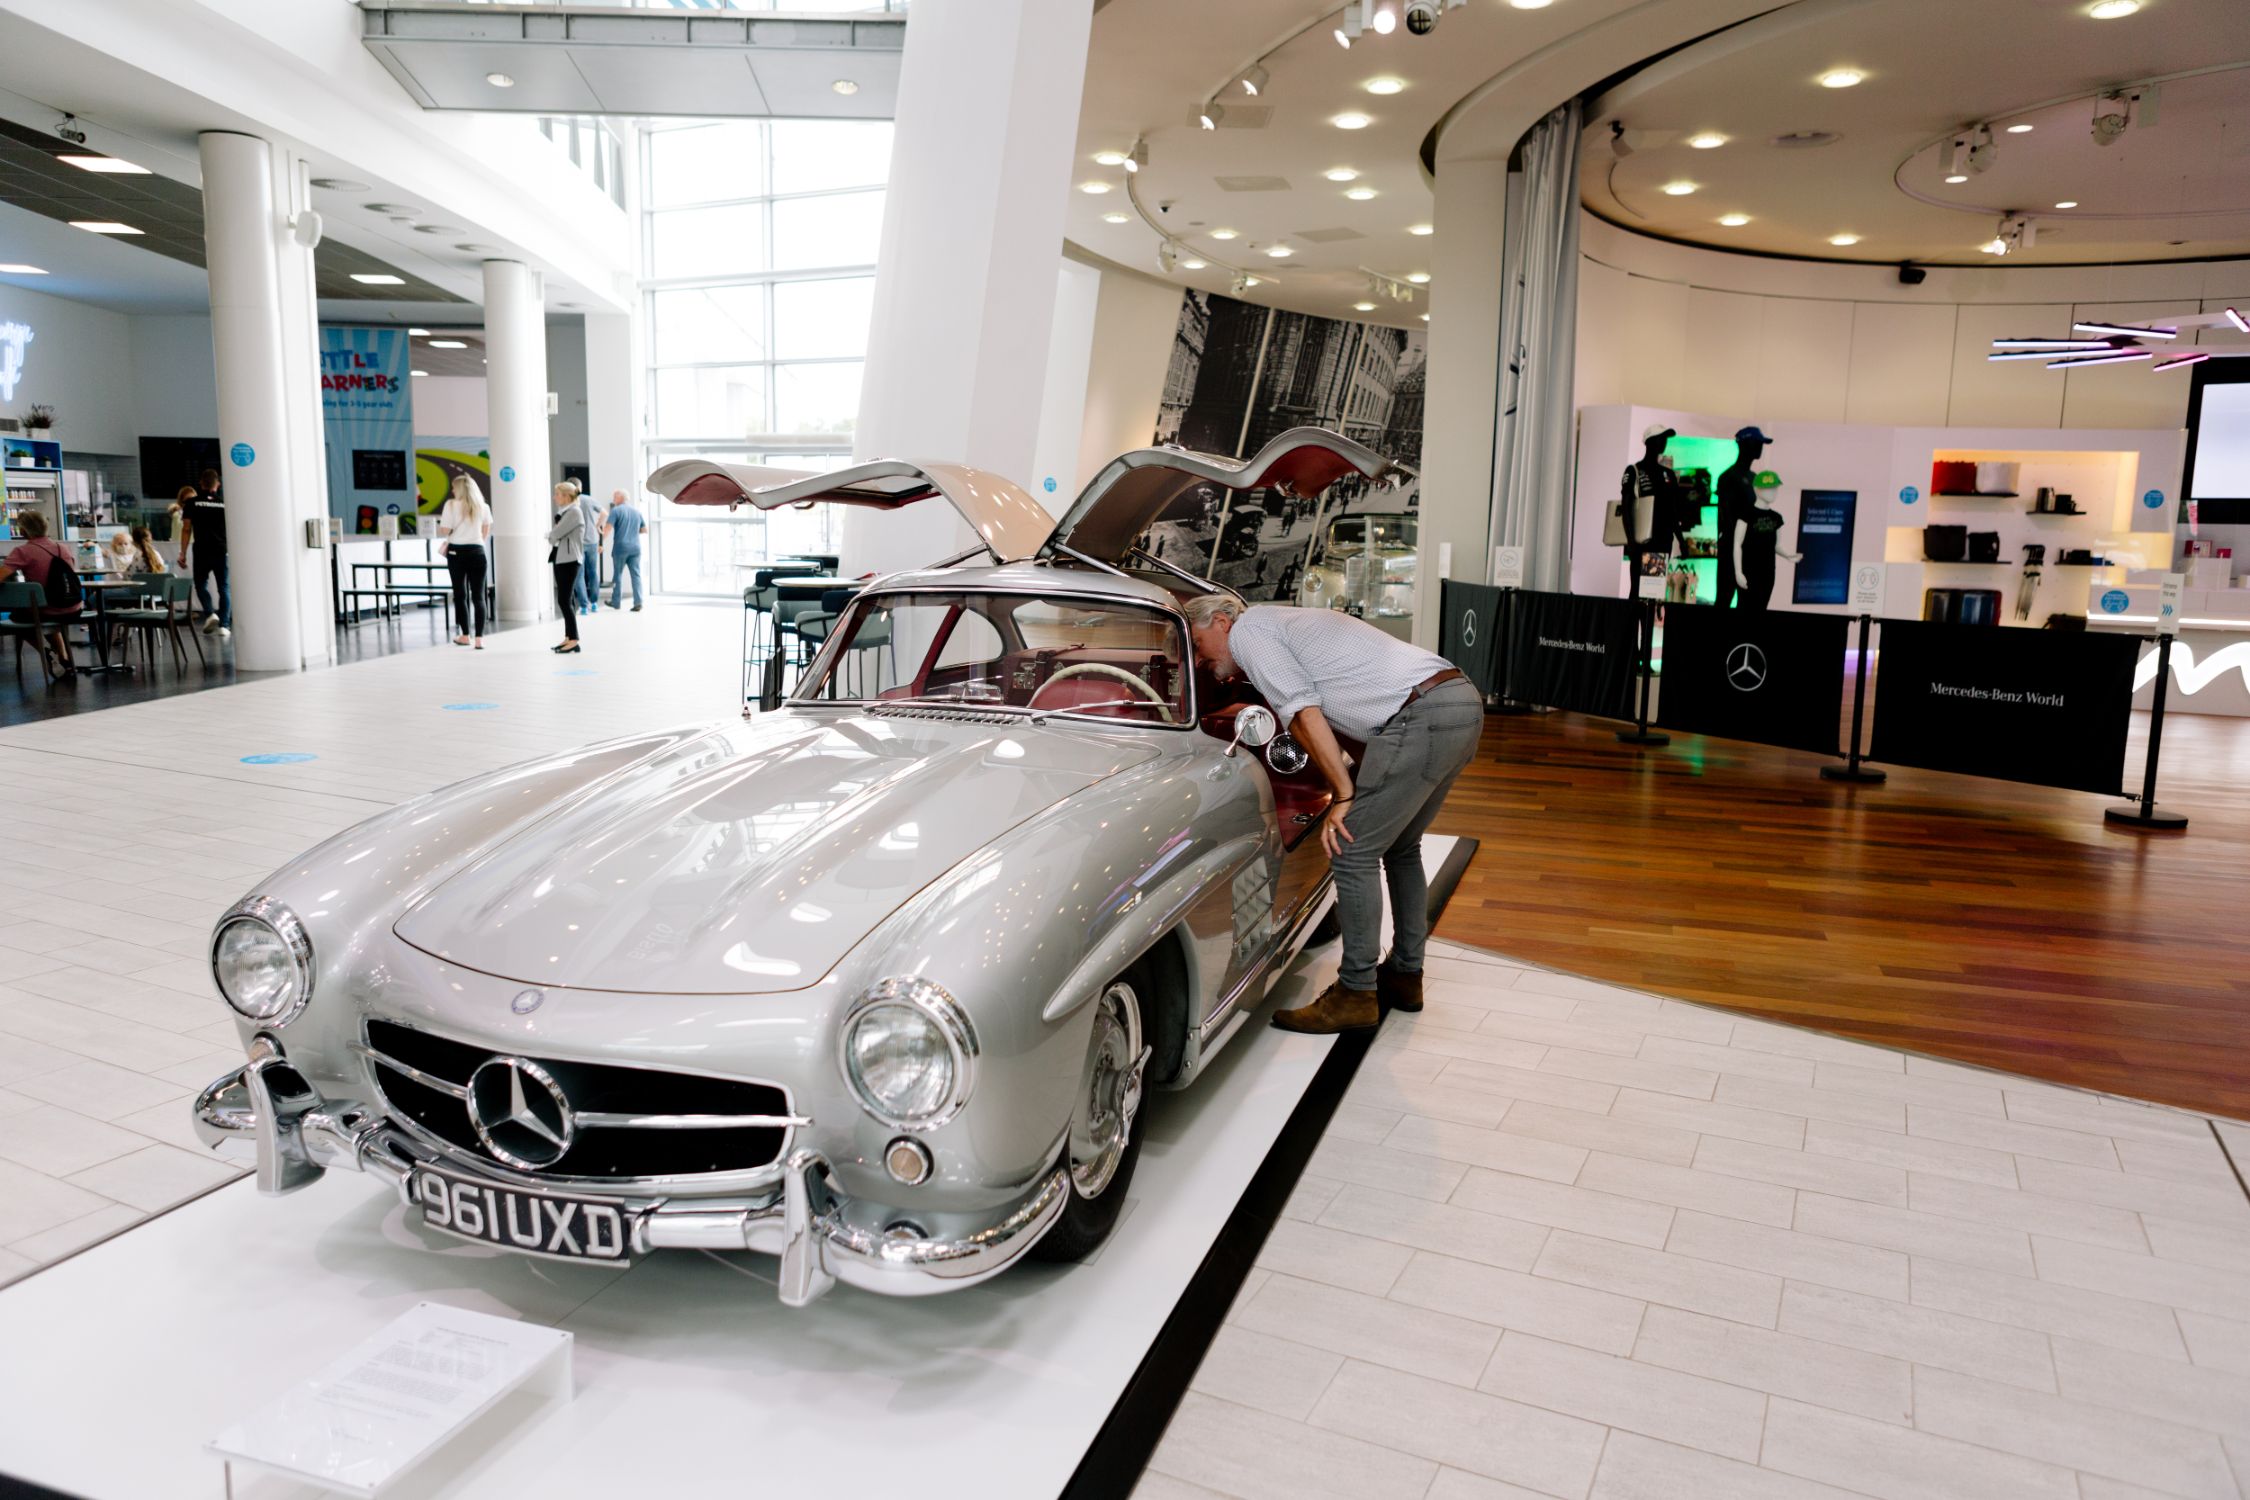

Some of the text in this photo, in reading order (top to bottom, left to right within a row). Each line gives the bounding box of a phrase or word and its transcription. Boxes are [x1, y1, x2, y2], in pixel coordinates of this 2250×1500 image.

[321, 373, 400, 394] ARNERS
[1538, 636, 1605, 654] Mercedes-Benz World
[1930, 682, 2064, 707] Mercedes-Benz World
